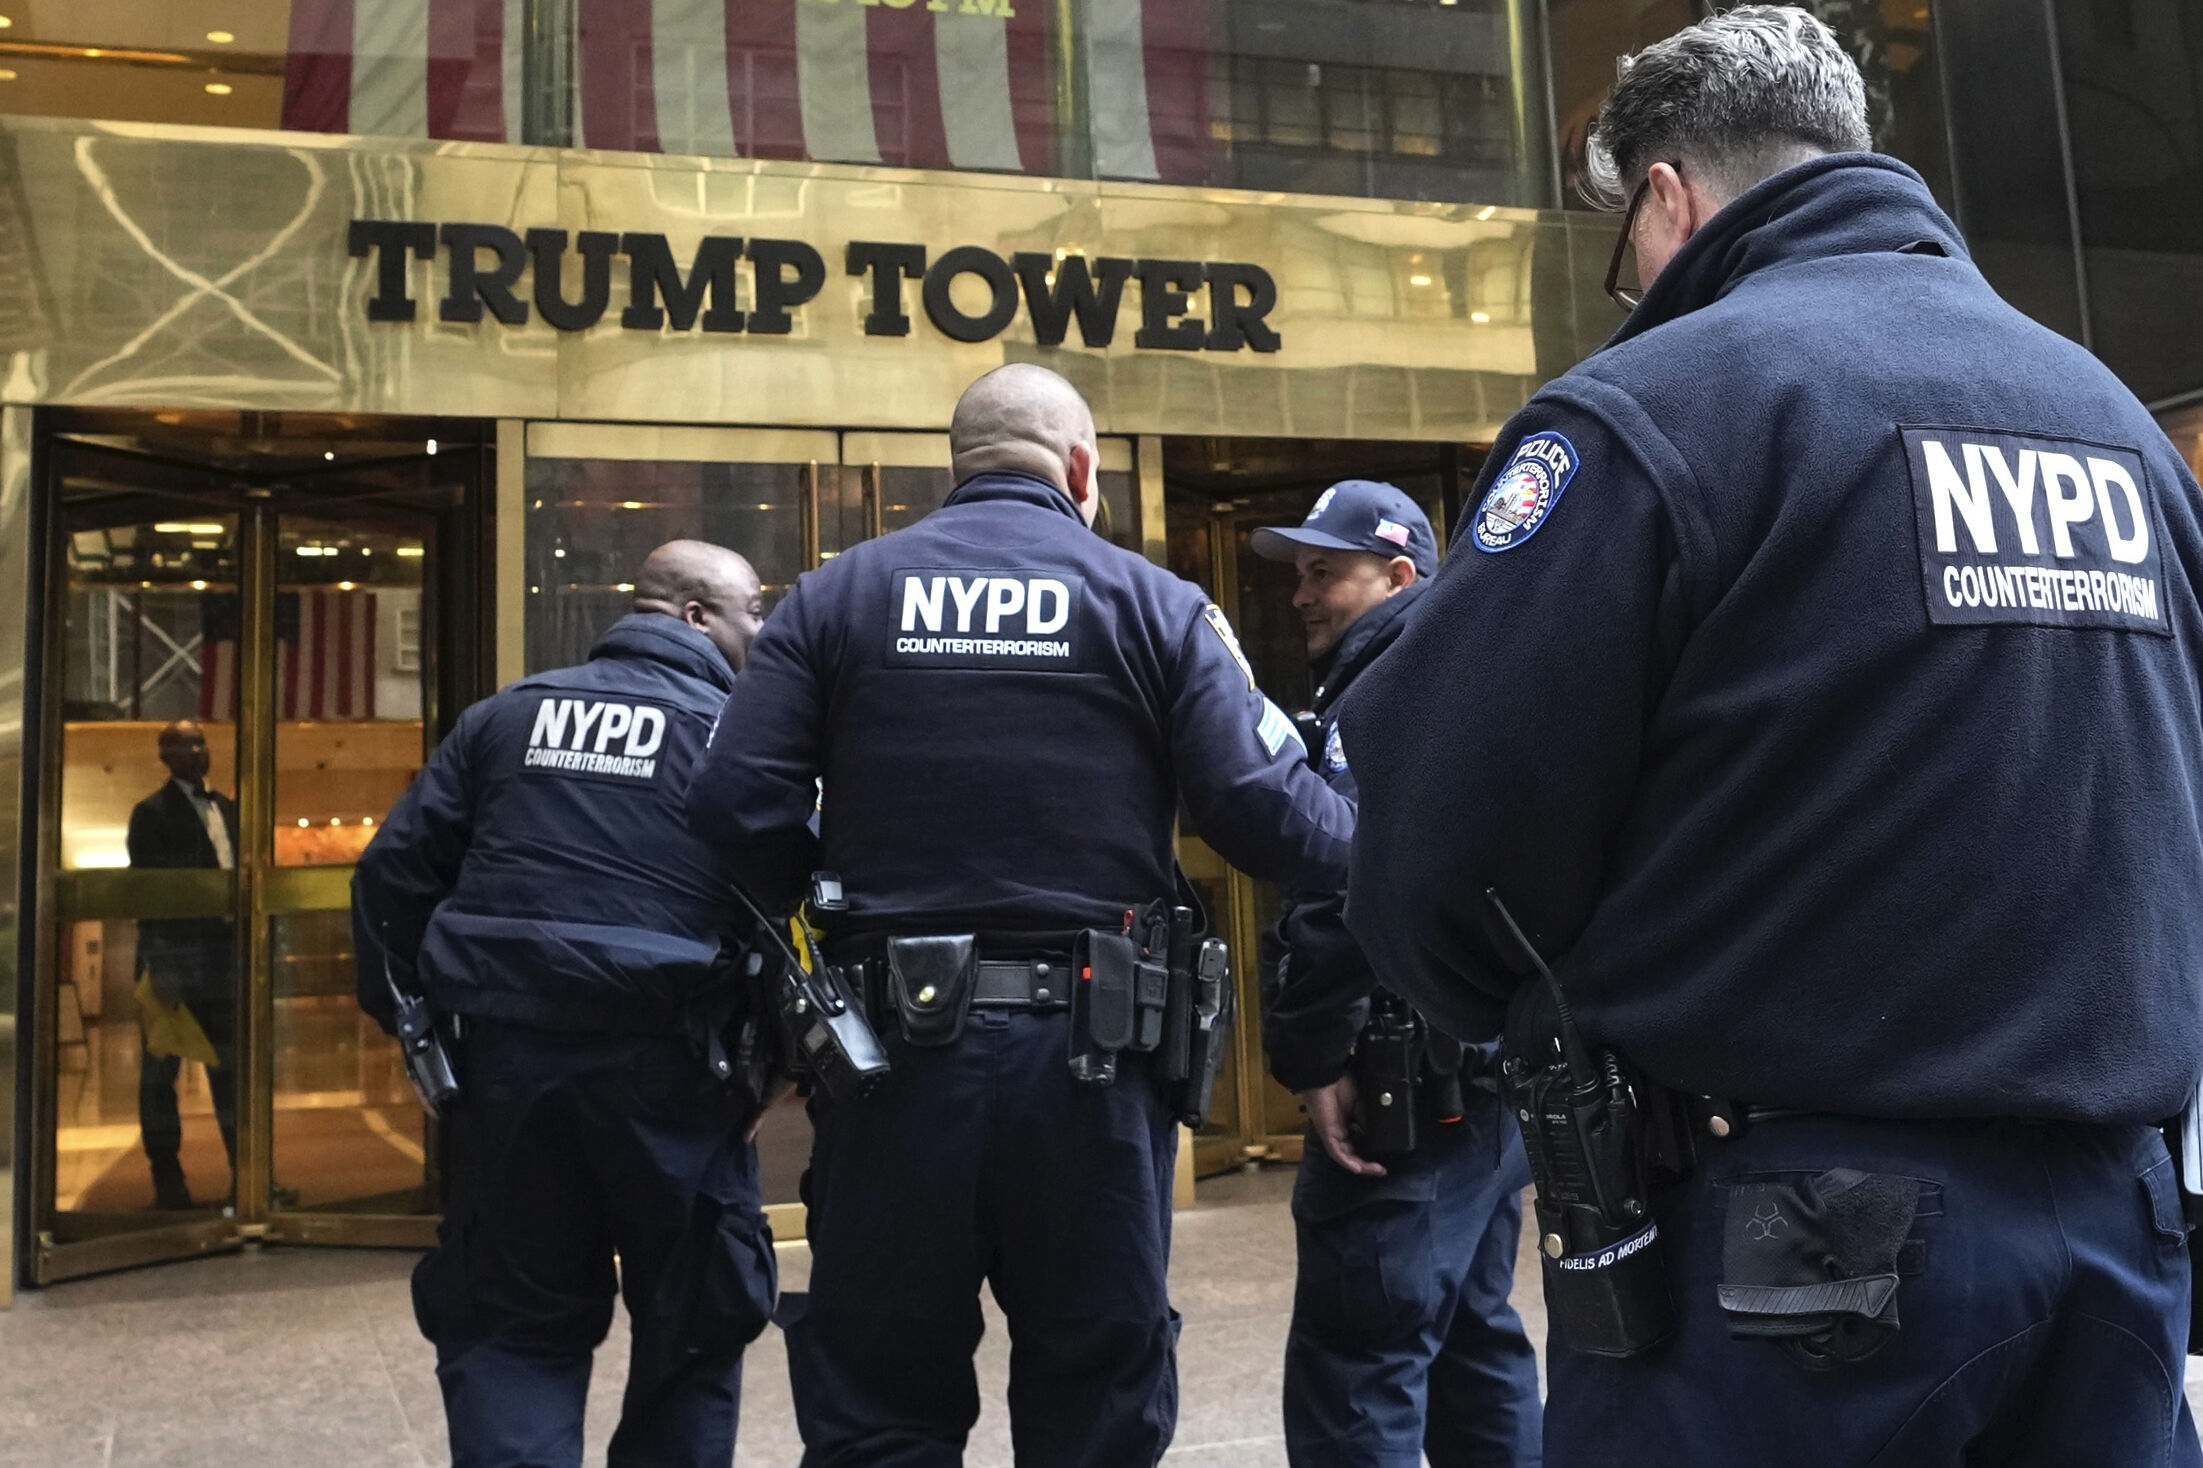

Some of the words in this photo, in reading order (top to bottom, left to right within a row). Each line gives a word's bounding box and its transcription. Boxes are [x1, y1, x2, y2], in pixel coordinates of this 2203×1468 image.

[348, 219, 826, 334] TRUMP
[845, 240, 1282, 352] TOWER
[1511, 439, 1571, 489] POLICE
[1921, 440, 2150, 564] NYPD
[1477, 521, 1512, 546] BUREAU
[900, 576, 1070, 635] NYPD
[1943, 565, 2160, 620] COUNTERTERRORISM
[896, 637, 1070, 657] COUNTERTERRORISM
[528, 698, 667, 757] NYPD
[524, 747, 656, 779] COUNTERTERRORISM
[1598, 1251, 1615, 1268] AD
